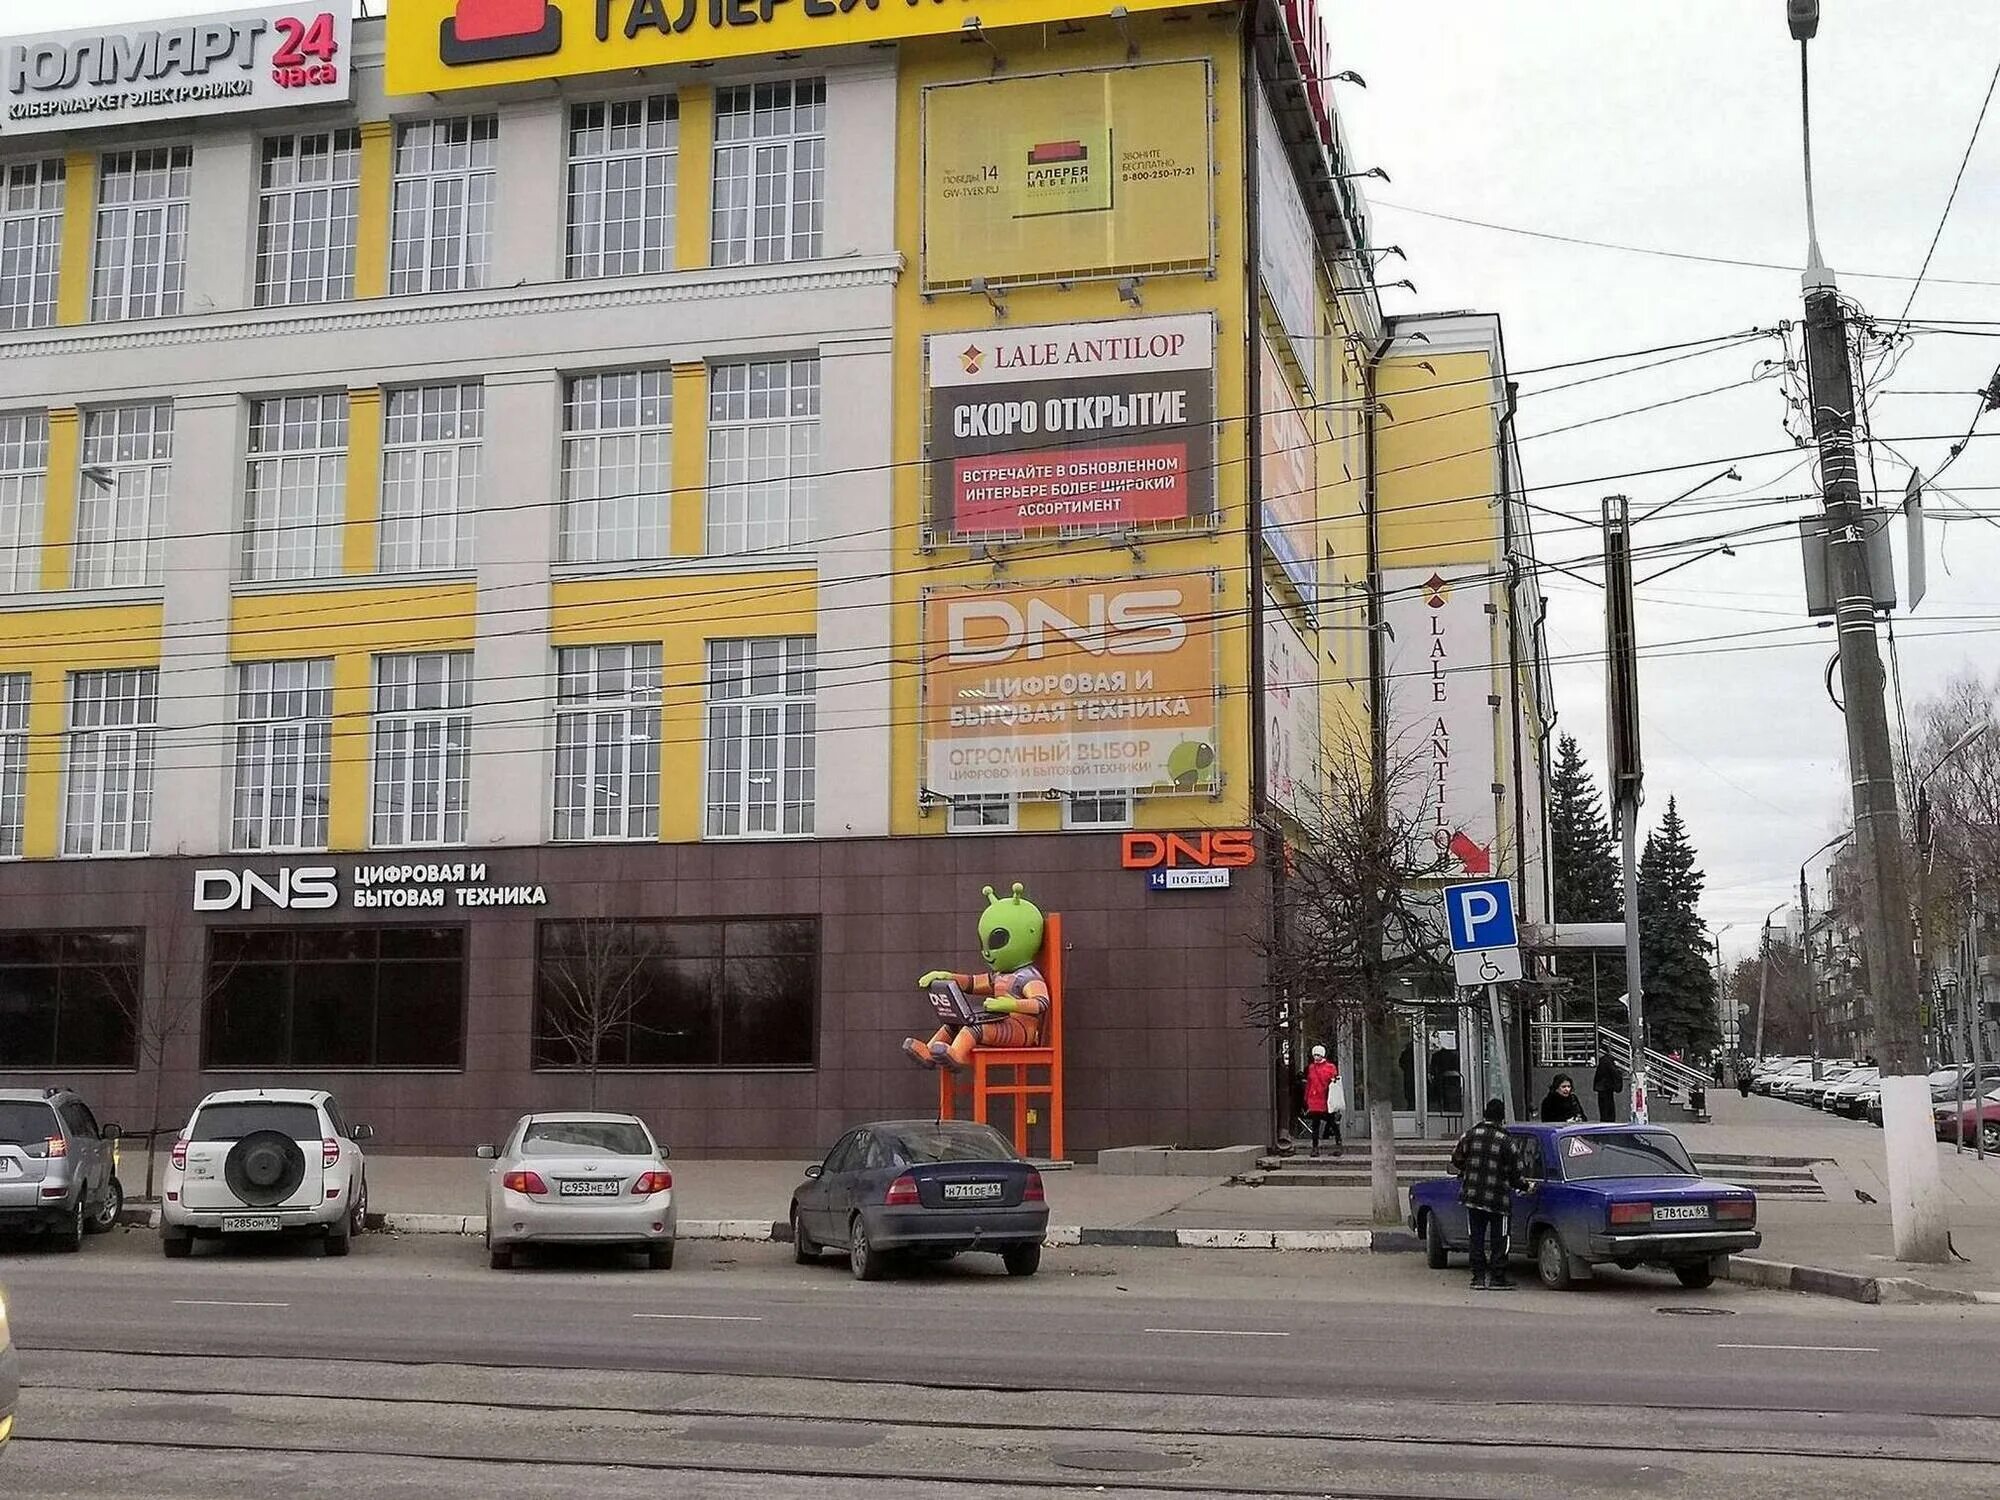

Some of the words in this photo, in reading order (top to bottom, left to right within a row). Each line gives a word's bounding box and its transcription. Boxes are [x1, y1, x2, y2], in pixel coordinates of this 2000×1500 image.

[272, 13, 338, 67] 24
[272, 62, 337, 88] часа
[9, 93, 130, 119] КИБЕРМАРКЕТ
[131, 80, 253, 107] ЭЛЕКТРОНИКИ
[1122, 150, 1161, 161] ЗВОНИТЕ
[1122, 160, 1175, 172] БЕСПЛАТНО
[981, 165, 998, 180] 14
[1027, 165, 1089, 180] ГАЛЕРЕЯ
[1027, 176, 1089, 188] МЕБЕЛИ
[1122, 168, 1195, 182] 8-800-250-17-21
[994, 345, 1060, 369] LALE
[1064, 333, 1186, 364] ANTILOP
[953, 400, 1038, 439] СКОРО
[1044, 390, 1188, 432] ОТКРЫТИЕ
[962, 464, 1053, 483] ВСТРЕЧАЙТЕ
[1055, 465, 1066, 476] В
[1068, 457, 1179, 475] ОБНОВЛЕННОМ
[965, 486, 1048, 501] ИНТЕРЬЕРЕ
[1050, 482, 1098, 495] БОЛЕЕ
[1100, 475, 1175, 493] ШИРОКИЙ
[1017, 498, 1122, 517] АССОРТИМЕНТ
[948, 589, 1188, 664] DNS
[1430, 616, 1447, 702] LALE
[984, 671, 1127, 700] ЦИФРОВАЯ
[1135, 670, 1153, 690] И
[950, 701, 1066, 727] БЫТОВАЯ
[1073, 695, 1192, 721] ТЕХНИКА
[950, 740, 1070, 766] ОГРОМНЫЙ
[1077, 740, 1150, 761] ВЫБОР
[950, 767, 1018, 780] ЦИФРОВО
[1021, 769, 1030, 777] И
[1431, 716, 1451, 850] ANTILO
[1122, 831, 1255, 868] DNS
[354, 864, 464, 886] ЦИФРОВАЯ
[470, 863, 486, 881] И
[1152, 874, 1165, 885] 14
[1172, 875, 1224, 885] ПОБЕДЫ
[194, 867, 338, 910] DNS
[353, 889, 444, 907] БЫТОВАЯ
[456, 887, 547, 906] ТЕХНИКА
[1461, 890, 1498, 943] P
[1656, 1208, 1694, 1219] Е781СА
